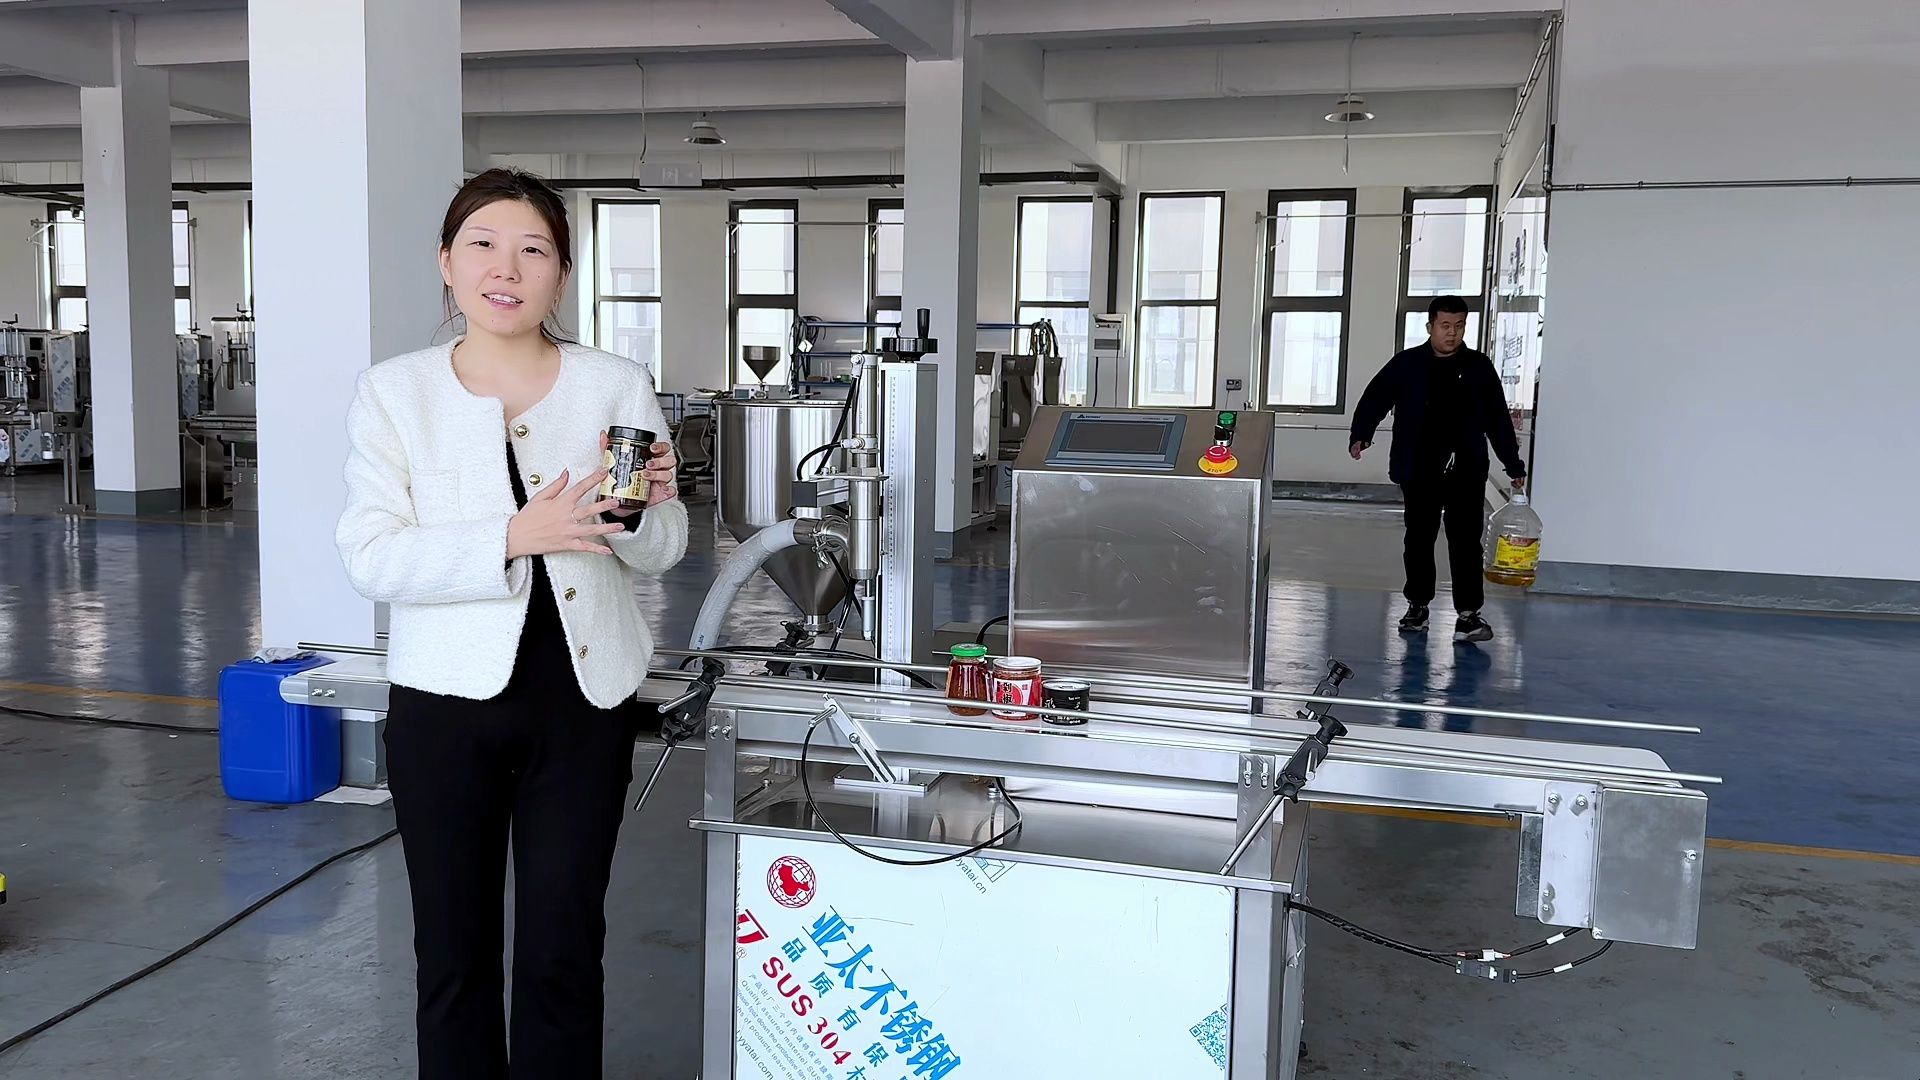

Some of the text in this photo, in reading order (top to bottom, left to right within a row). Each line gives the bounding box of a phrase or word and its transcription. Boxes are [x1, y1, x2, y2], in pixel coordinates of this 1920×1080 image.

[741, 980, 761, 1006] Quality
[761, 1007, 785, 1035] assured
[762, 957, 813, 1016] SUS
[807, 1016, 852, 1065] 304
[781, 937, 907, 1080] 品质有保
[802, 905, 961, 1080] 亚太不锈钢
[749, 1025, 772, 1053] products
[771, 1053, 786, 1071] leave
[757, 1017, 770, 1034] down
[769, 1032, 777, 1043] the
[775, 1043, 798, 1070] protective
